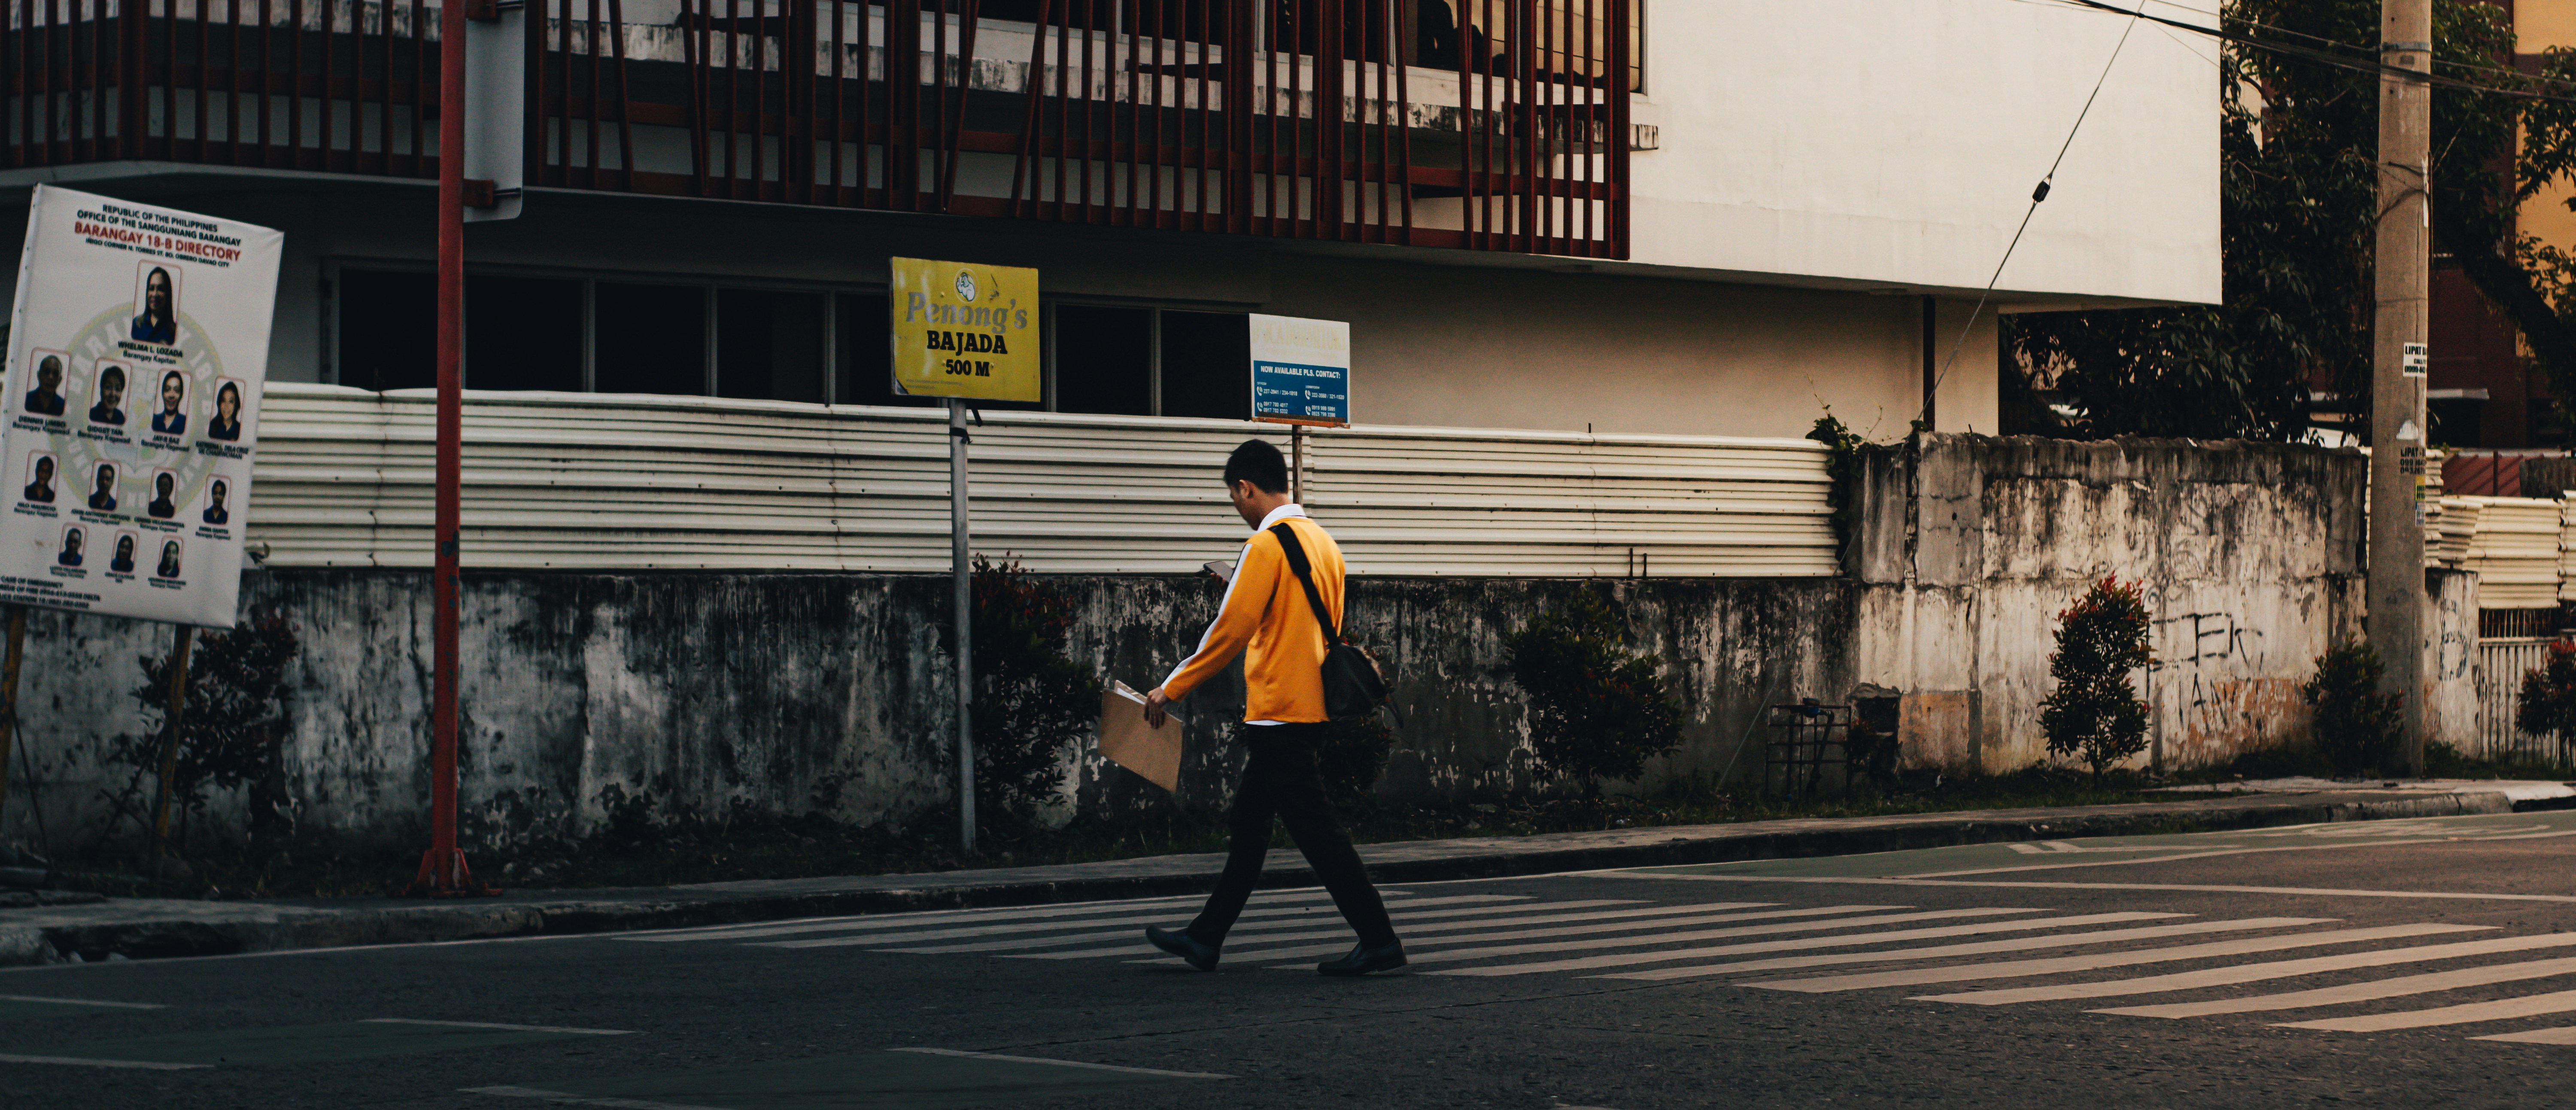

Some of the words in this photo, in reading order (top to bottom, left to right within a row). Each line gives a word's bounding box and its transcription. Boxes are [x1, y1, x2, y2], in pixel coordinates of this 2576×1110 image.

[103, 204, 140, 218] REPUBLIC
[142, 212, 153, 220] OF
[155, 214, 169, 224] THE
[171, 217, 217, 232] PHILIPPINES
[77, 209, 106, 223] OFFICE
[108, 215, 119, 224] OF
[121, 218, 136, 228] THE
[138, 221, 197, 239] SANGGUNIANG
[199, 232, 241, 246] BARANGAY
[74, 221, 143, 245] BARANGAY
[147, 234, 172, 250] 18-B
[175, 239, 240, 261] DIRECTORY
[104, 240, 127, 250] CORNER
[135, 246, 155, 255] TORRES
[198, 257, 216, 265] DAVAO
[905, 291, 1027, 334] Penong's
[118, 340, 148, 352] WHELMA
[156, 347, 183, 358] LOZADA
[927, 330, 1008, 356] BAJADA
[2405, 346, 2421, 355] LIPAT
[123, 350, 152, 362] Barangay
[153, 355, 176, 364] Kapitan
[945, 359, 972, 376] 500
[975, 361, 990, 376] M
[1274, 367, 1302, 376] AVAILABLE
[1316, 370, 1340, 379] CONTACT:
[12, 421, 40, 433] Barangay
[42, 425, 70, 435] Kagawad
[18, 415, 43, 425] DENNIS
[77, 429, 103, 441] Barangay
[105, 434, 131, 444] Kagawad
[141, 439, 164, 449] Barangay
[166, 443, 189, 452] Kagawad
[0, 575, 17, 583] CASE
[27, 578, 64, 588] EMERGENCY
